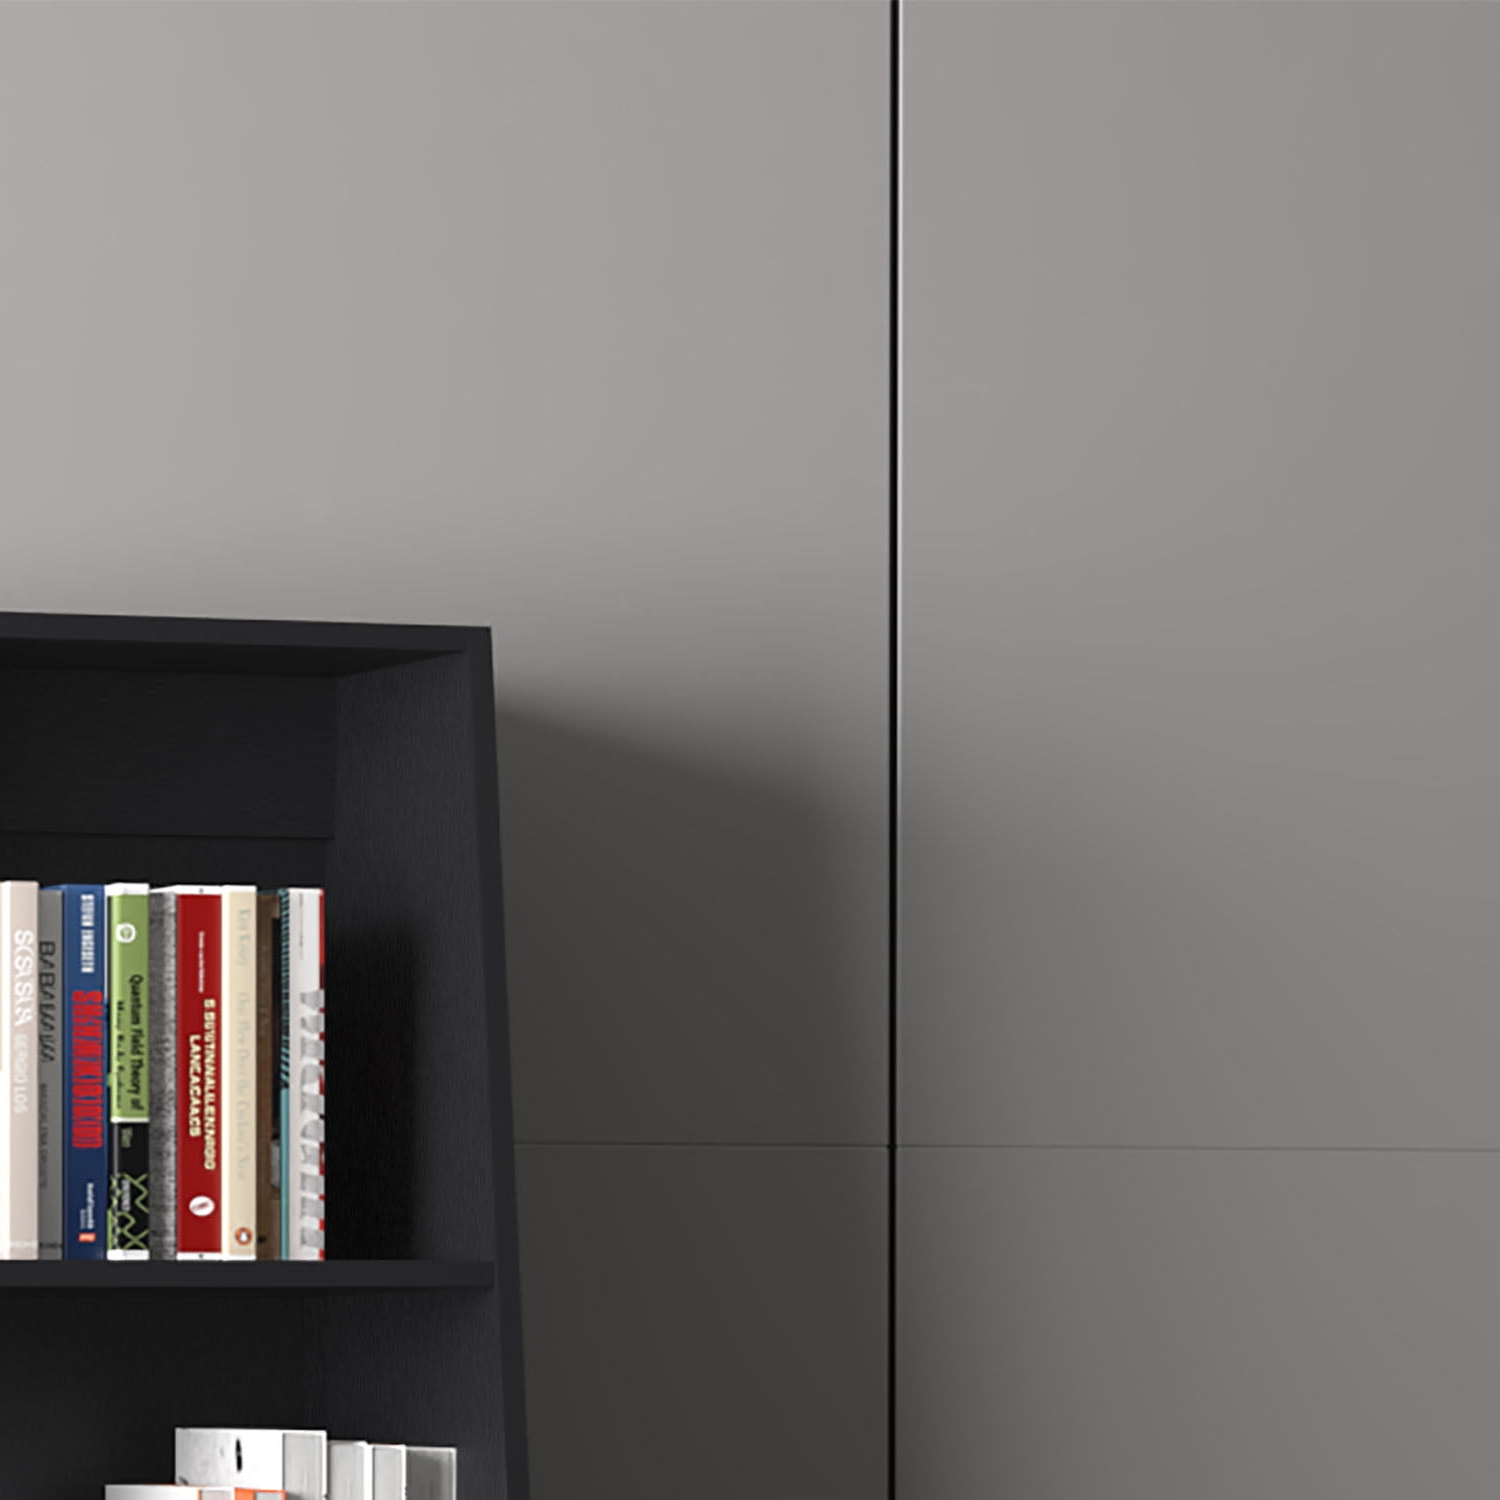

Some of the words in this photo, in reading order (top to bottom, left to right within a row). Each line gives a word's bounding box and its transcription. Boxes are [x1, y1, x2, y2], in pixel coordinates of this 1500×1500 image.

[129, 973, 145, 1025] Quantum
[130, 1028, 145, 1056] Field
[127, 1058, 145, 1095] Theory
[131, 1098, 145, 1111] of
